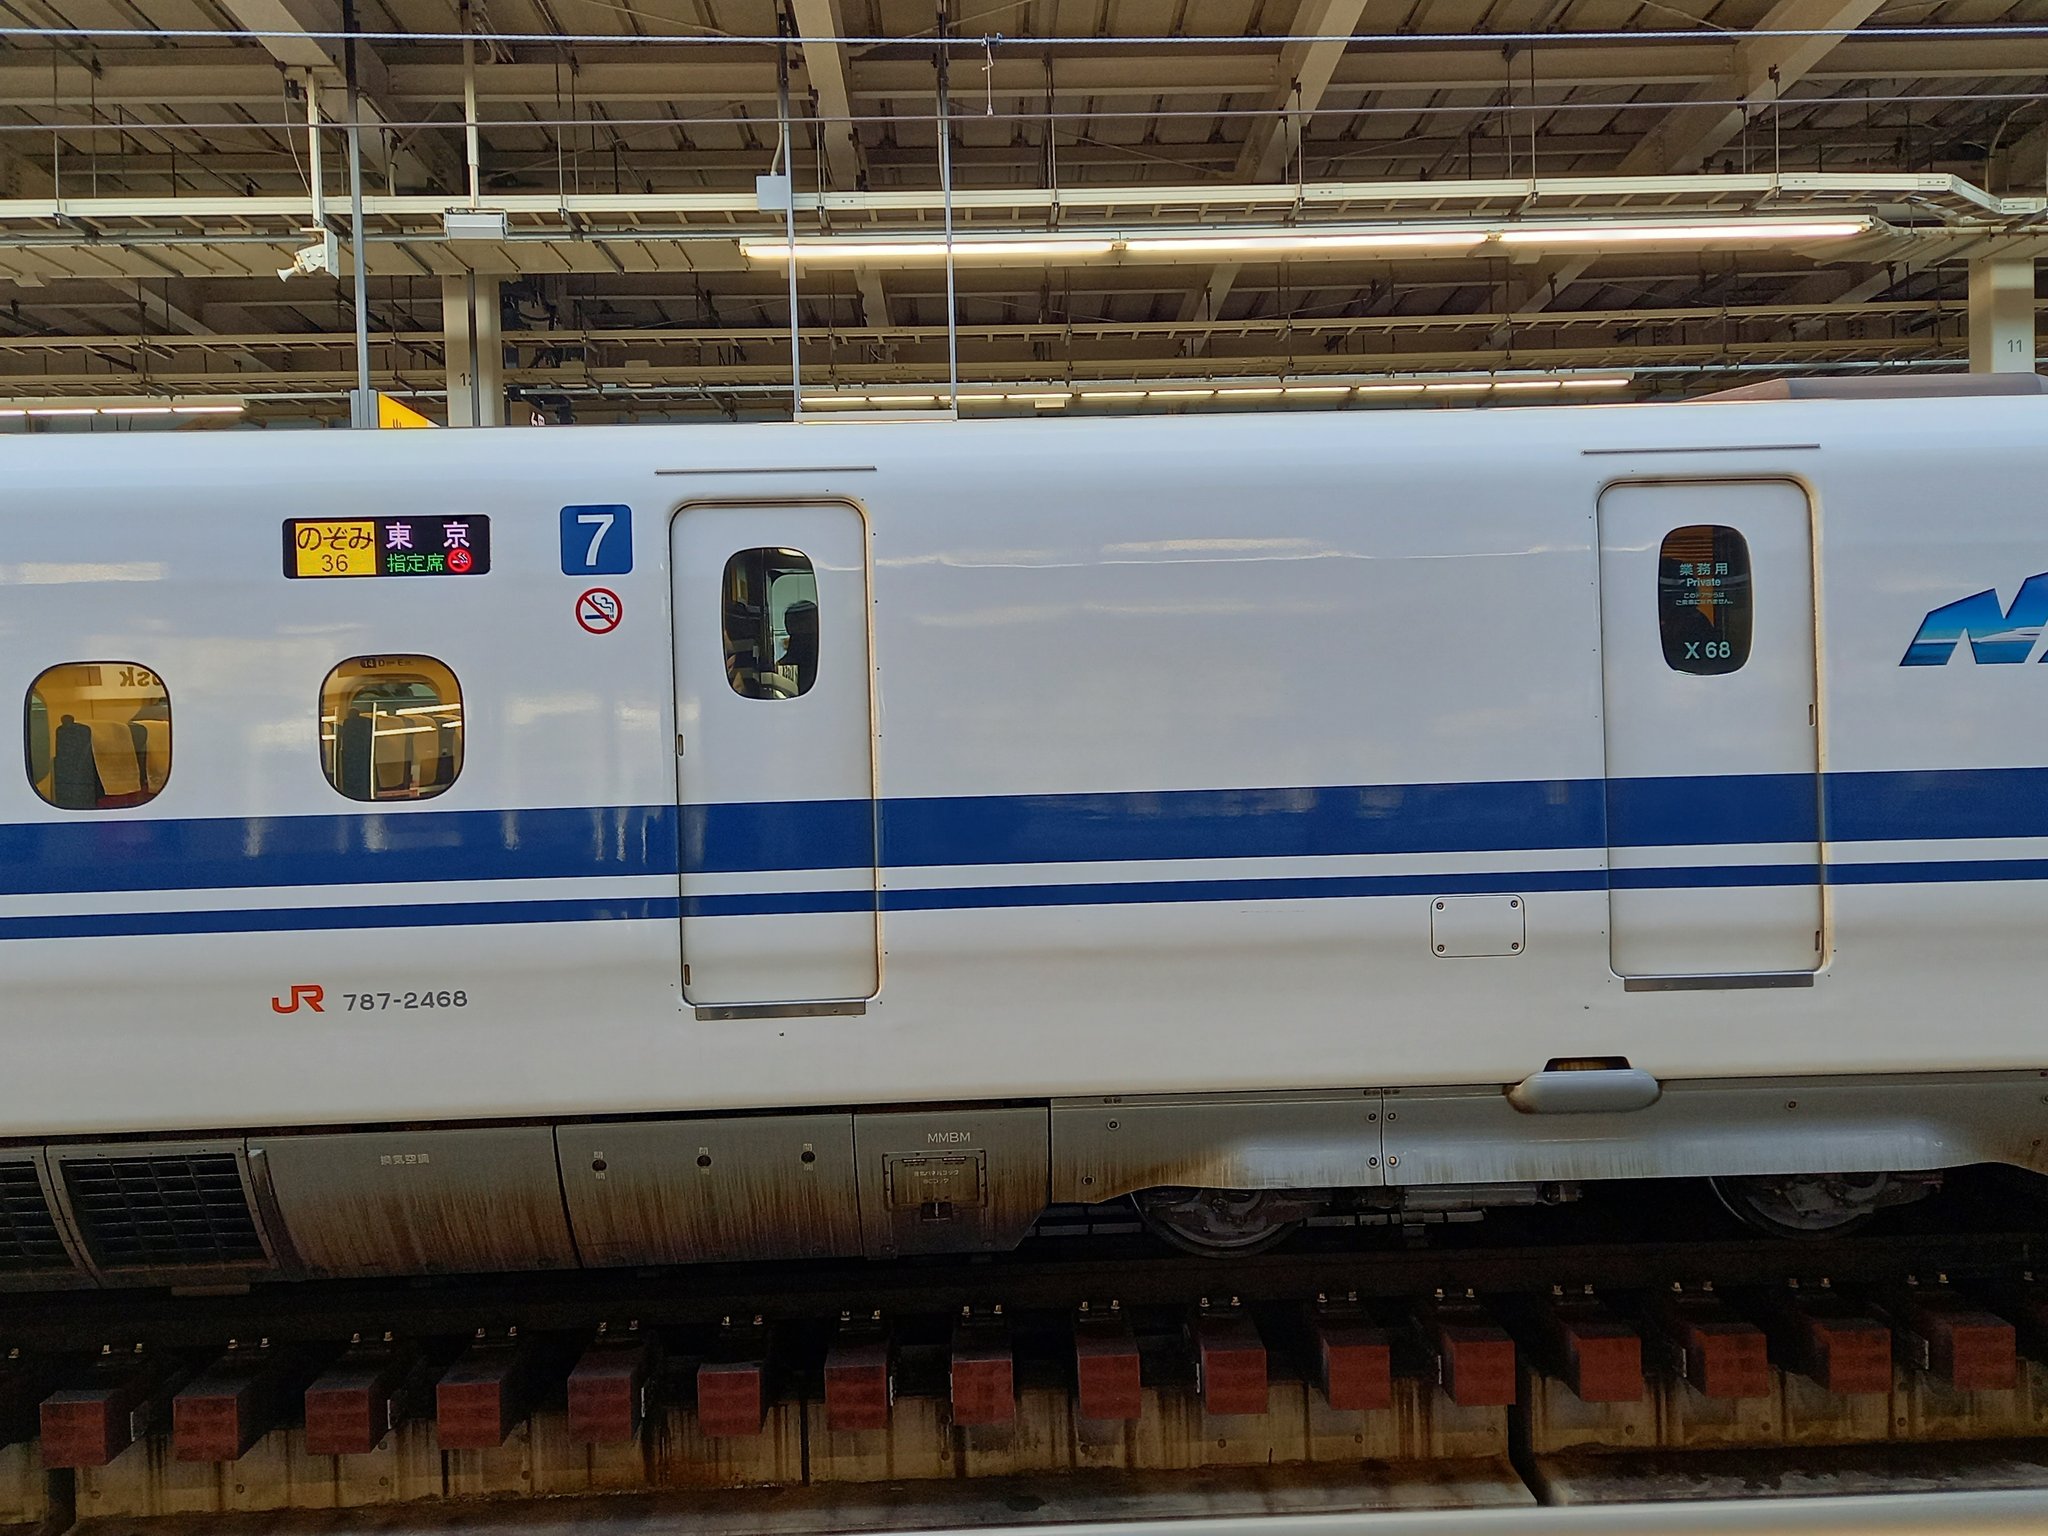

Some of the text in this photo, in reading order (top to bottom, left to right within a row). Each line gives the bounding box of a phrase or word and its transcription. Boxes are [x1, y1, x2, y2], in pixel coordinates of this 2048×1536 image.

[2007, 339, 2022, 353] 11
[460, 372, 472, 387] 1
[296, 526, 374, 551] のぞみ
[385, 521, 471, 550] 東京
[577, 513, 615, 567] 7
[320, 553, 349, 573] 36
[386, 552, 446, 574] 指定席
[1679, 562, 1729, 576] 業務用
[1686, 577, 1721, 587] Private
[271, 984, 468, 1014] JR 787-2468
[927, 1131, 971, 1144] MMBM
